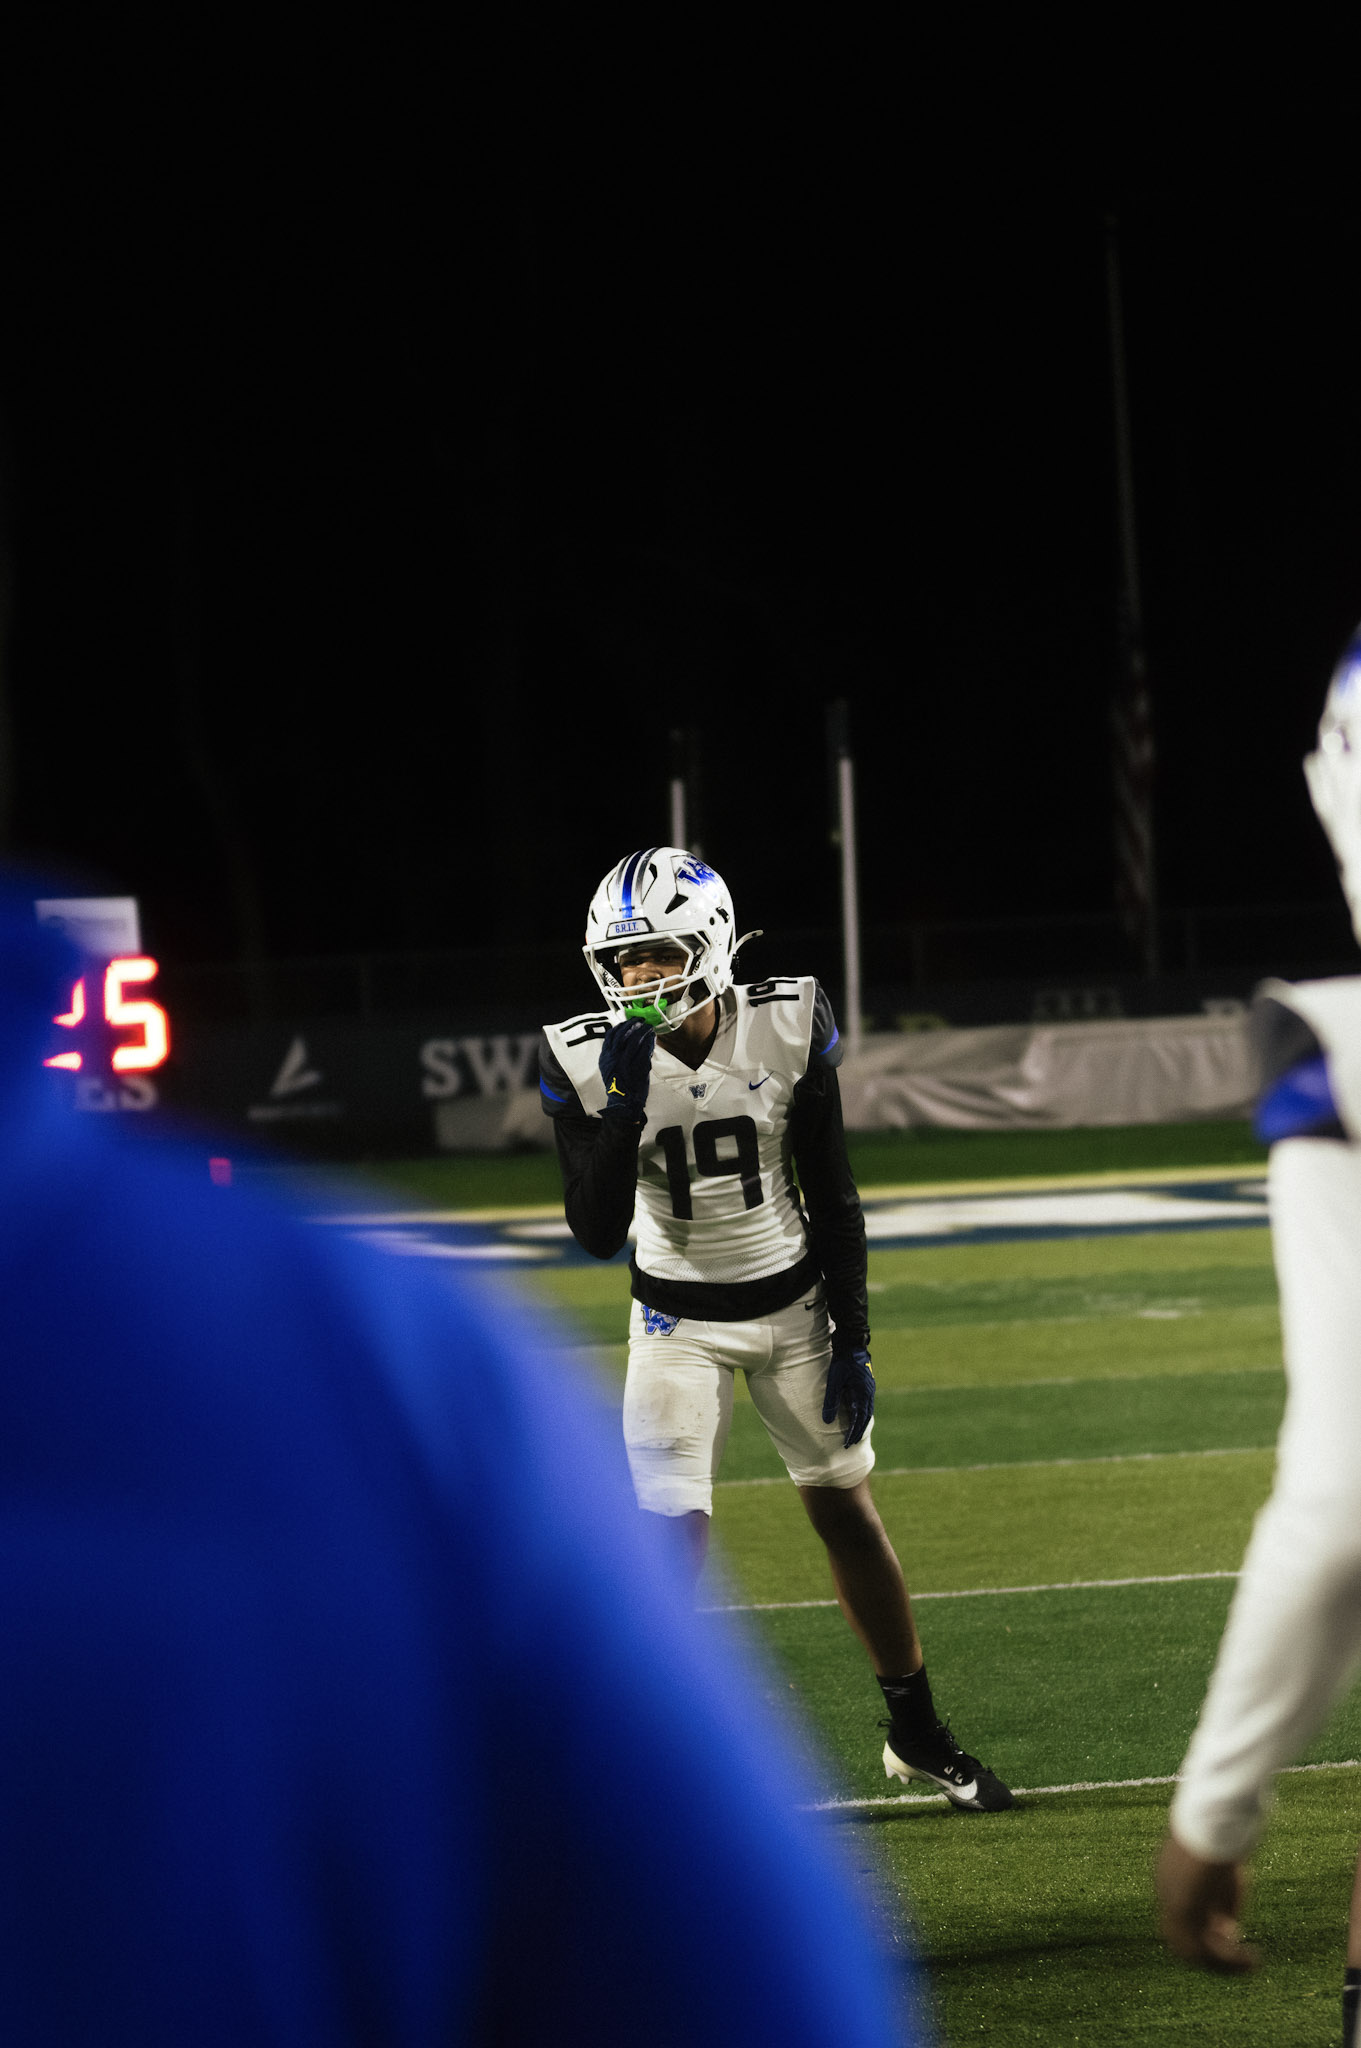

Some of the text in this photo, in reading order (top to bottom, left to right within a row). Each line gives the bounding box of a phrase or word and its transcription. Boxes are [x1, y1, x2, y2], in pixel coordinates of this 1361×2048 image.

[746, 979, 800, 1008] 19
[560, 1015, 613, 1047] 19
[655, 1115, 764, 1220] 19
